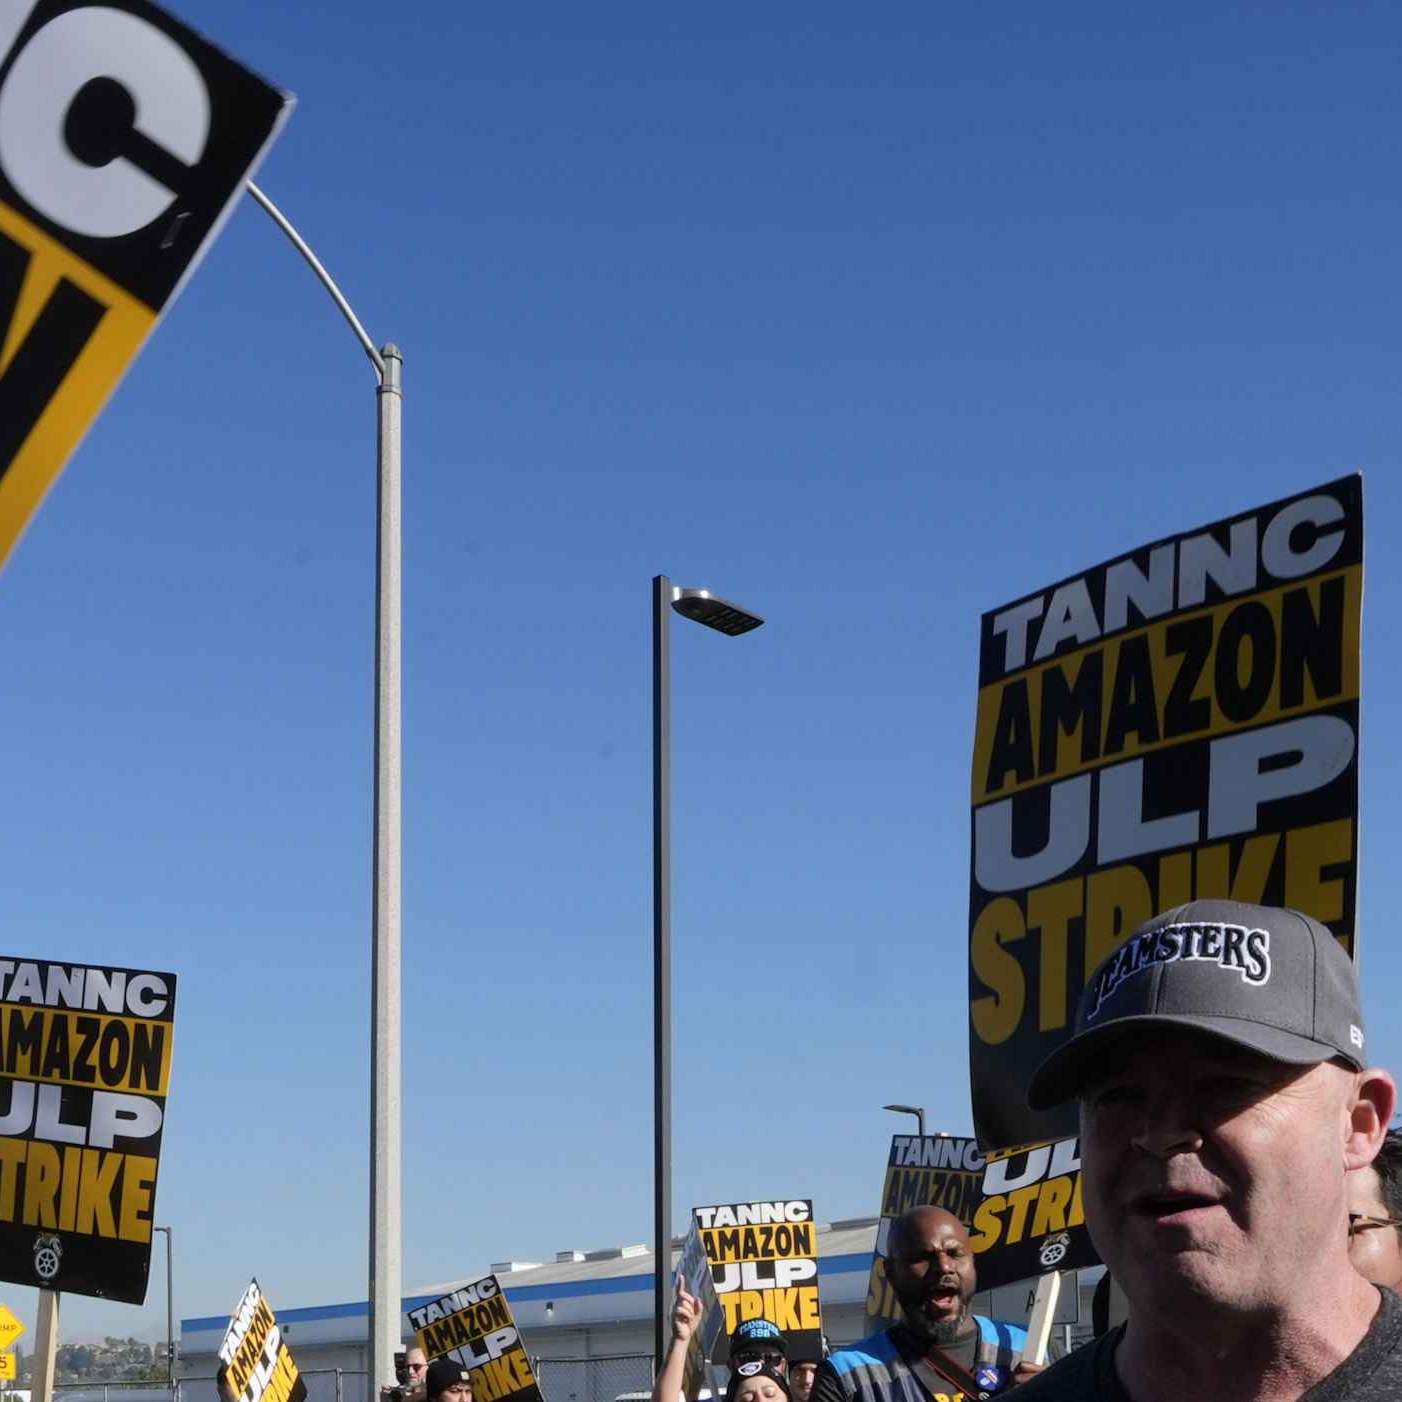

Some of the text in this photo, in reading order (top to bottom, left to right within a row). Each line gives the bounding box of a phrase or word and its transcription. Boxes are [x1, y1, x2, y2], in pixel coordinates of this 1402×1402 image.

[992, 494, 1347, 673] TANNC
[985, 574, 1347, 796] AMAZON
[973, 714, 1355, 893] ULP
[894, 1137, 987, 1172] TANNC
[696, 1200, 809, 1229] TANNC
[702, 1224, 811, 1262] AMAZON
[219, 1282, 260, 1366] TANNC
[410, 1278, 497, 1328] TANNC
[423, 1297, 509, 1358] AMAZON
[230, 1298, 273, 1394] AMAZON
